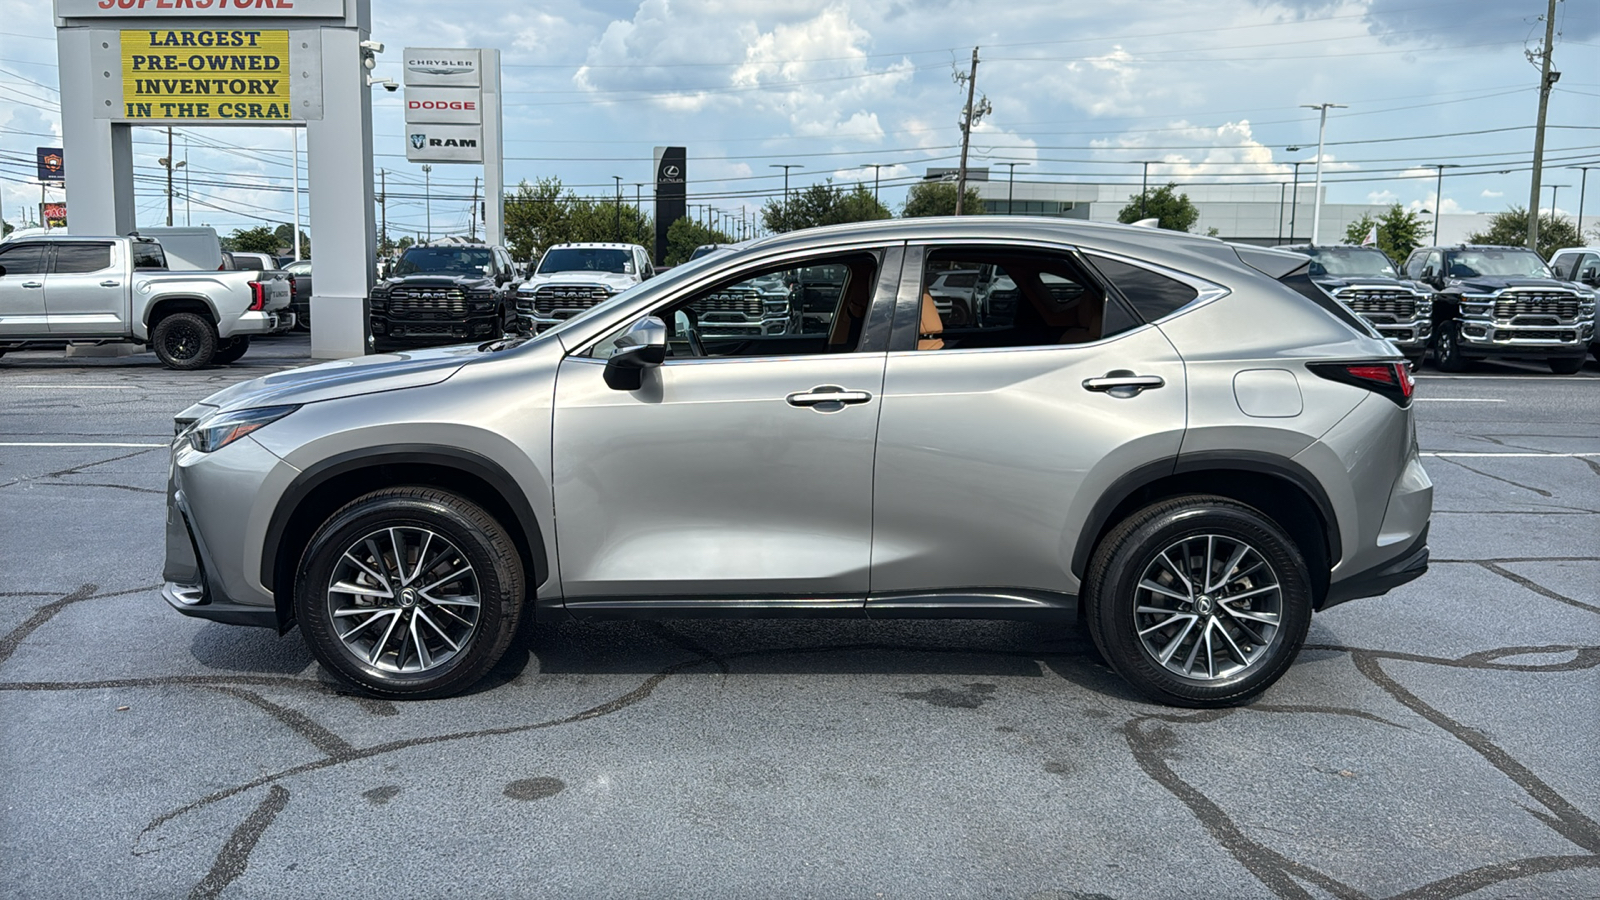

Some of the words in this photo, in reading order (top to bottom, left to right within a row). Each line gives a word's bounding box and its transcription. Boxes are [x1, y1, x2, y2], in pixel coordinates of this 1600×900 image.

[149, 31, 261, 46] LARGEST
[132, 55, 280, 70] PRE-OWNED
[135, 79, 279, 94] INVENTORY
[126, 103, 152, 117] IN
[160, 103, 210, 117] THE
[217, 103, 289, 118] CSRA!
[408, 101, 476, 110] DODGE
[429, 138, 477, 148] RAM
